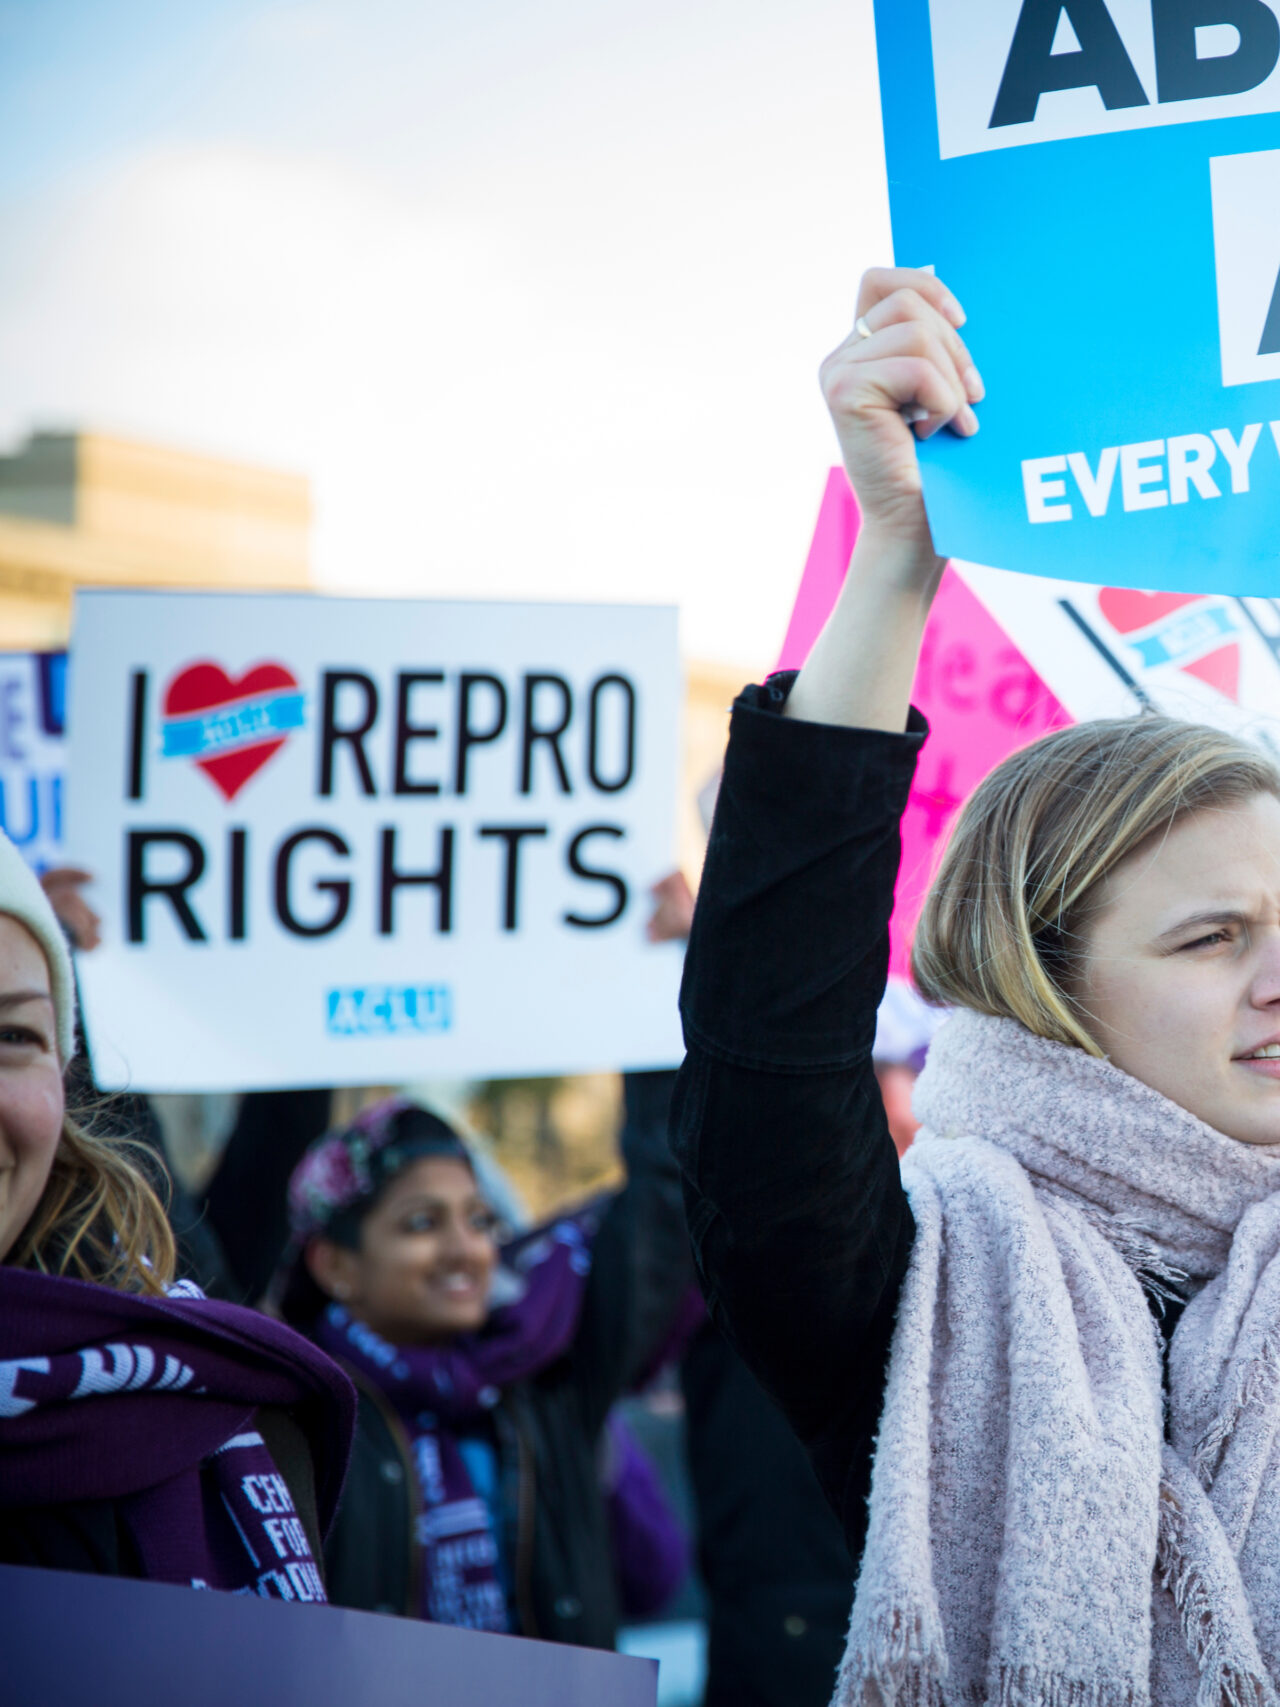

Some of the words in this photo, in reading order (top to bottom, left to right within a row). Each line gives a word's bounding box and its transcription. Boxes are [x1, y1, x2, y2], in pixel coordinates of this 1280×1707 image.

[1021, 423, 1263, 524] EVERY
[126, 669, 149, 802] I
[317, 665, 638, 799] REPRO
[124, 823, 629, 946] RIGHTS
